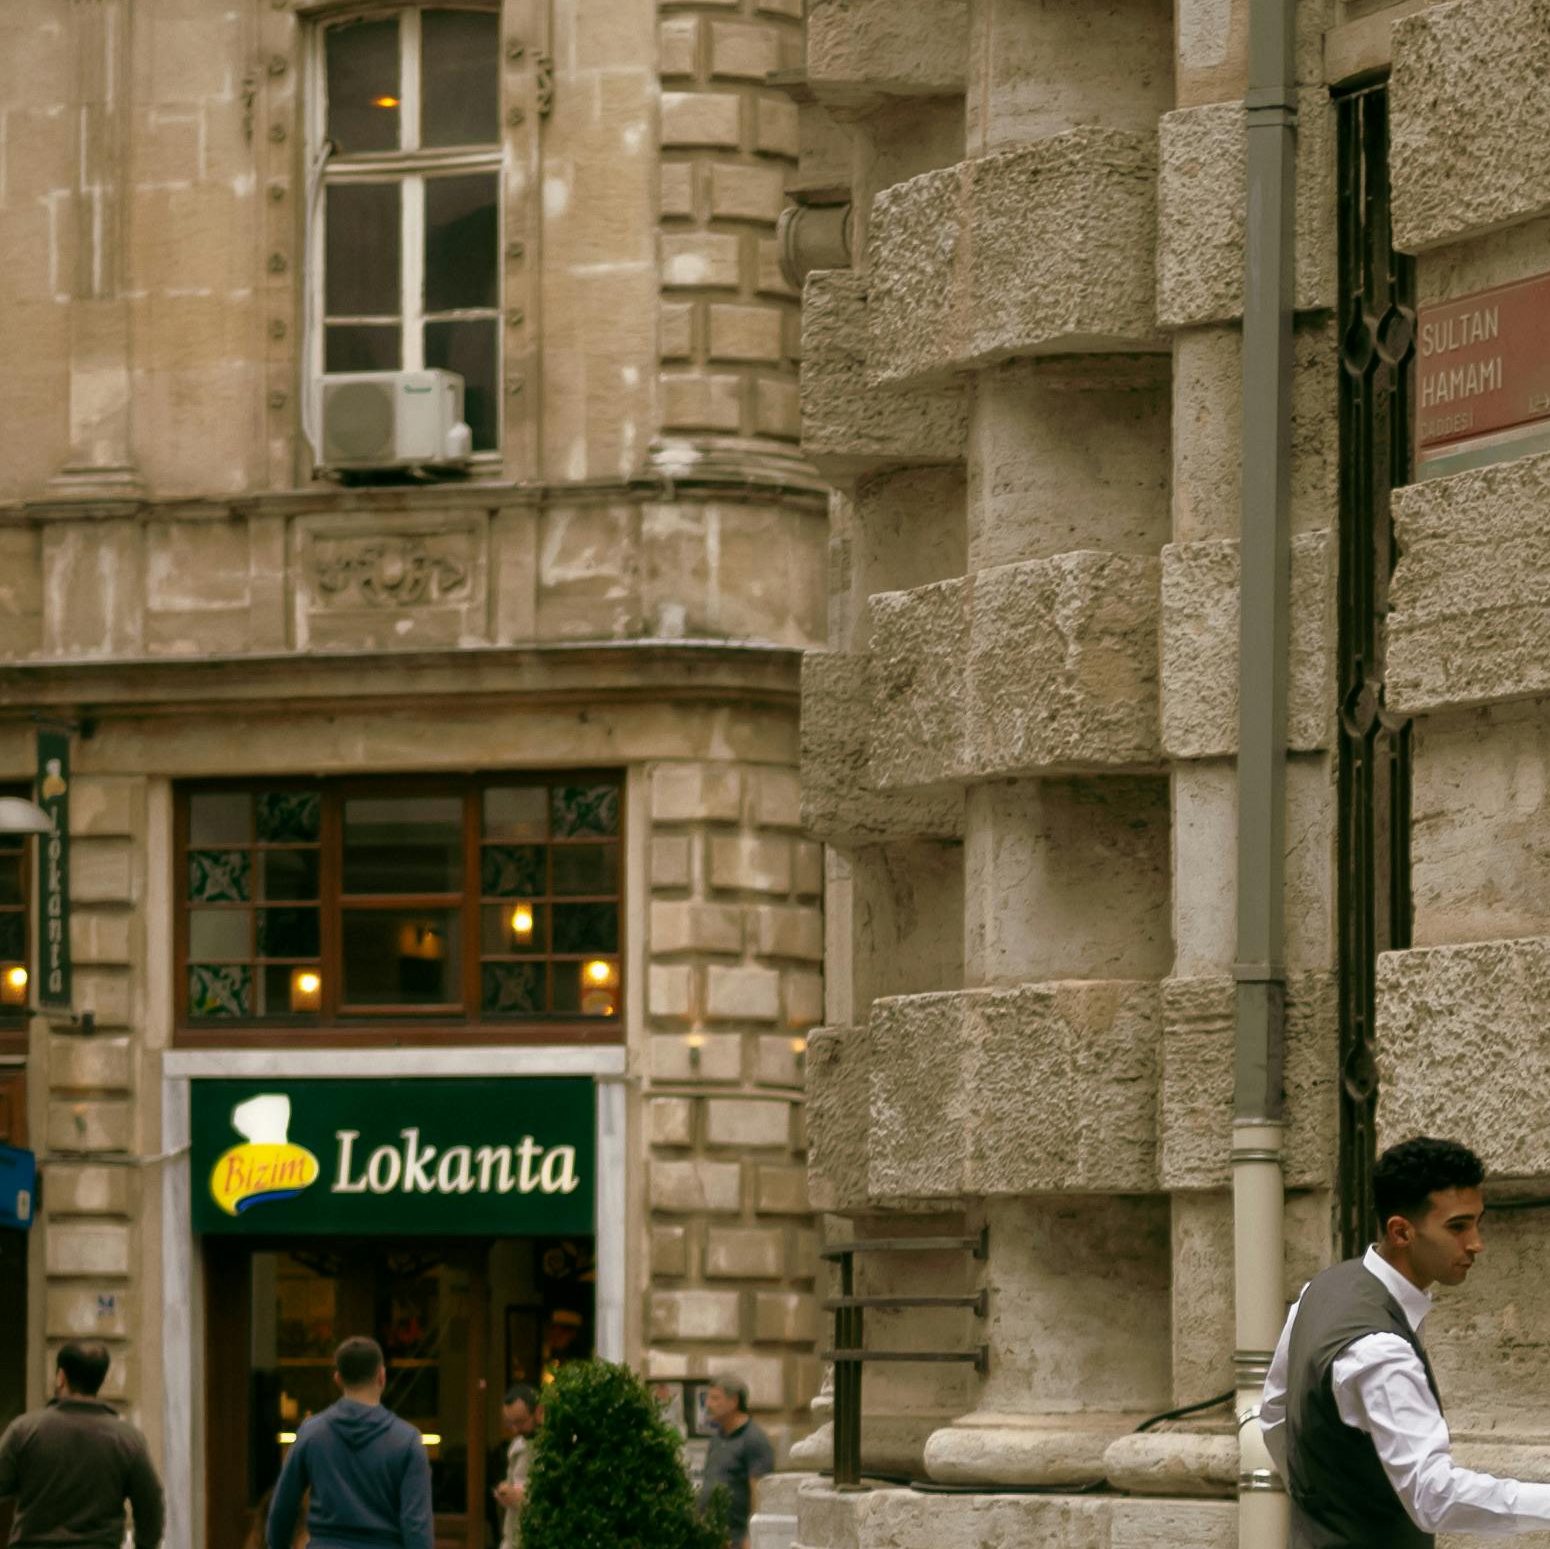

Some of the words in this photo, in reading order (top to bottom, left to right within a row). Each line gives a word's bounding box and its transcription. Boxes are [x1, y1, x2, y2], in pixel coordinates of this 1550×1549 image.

[1422, 306, 1499, 357] SULTAN
[1421, 356, 1503, 408] HAMAMI
[224, 1153, 307, 1193] Bizim
[332, 1126, 580, 1194] Lokanta
